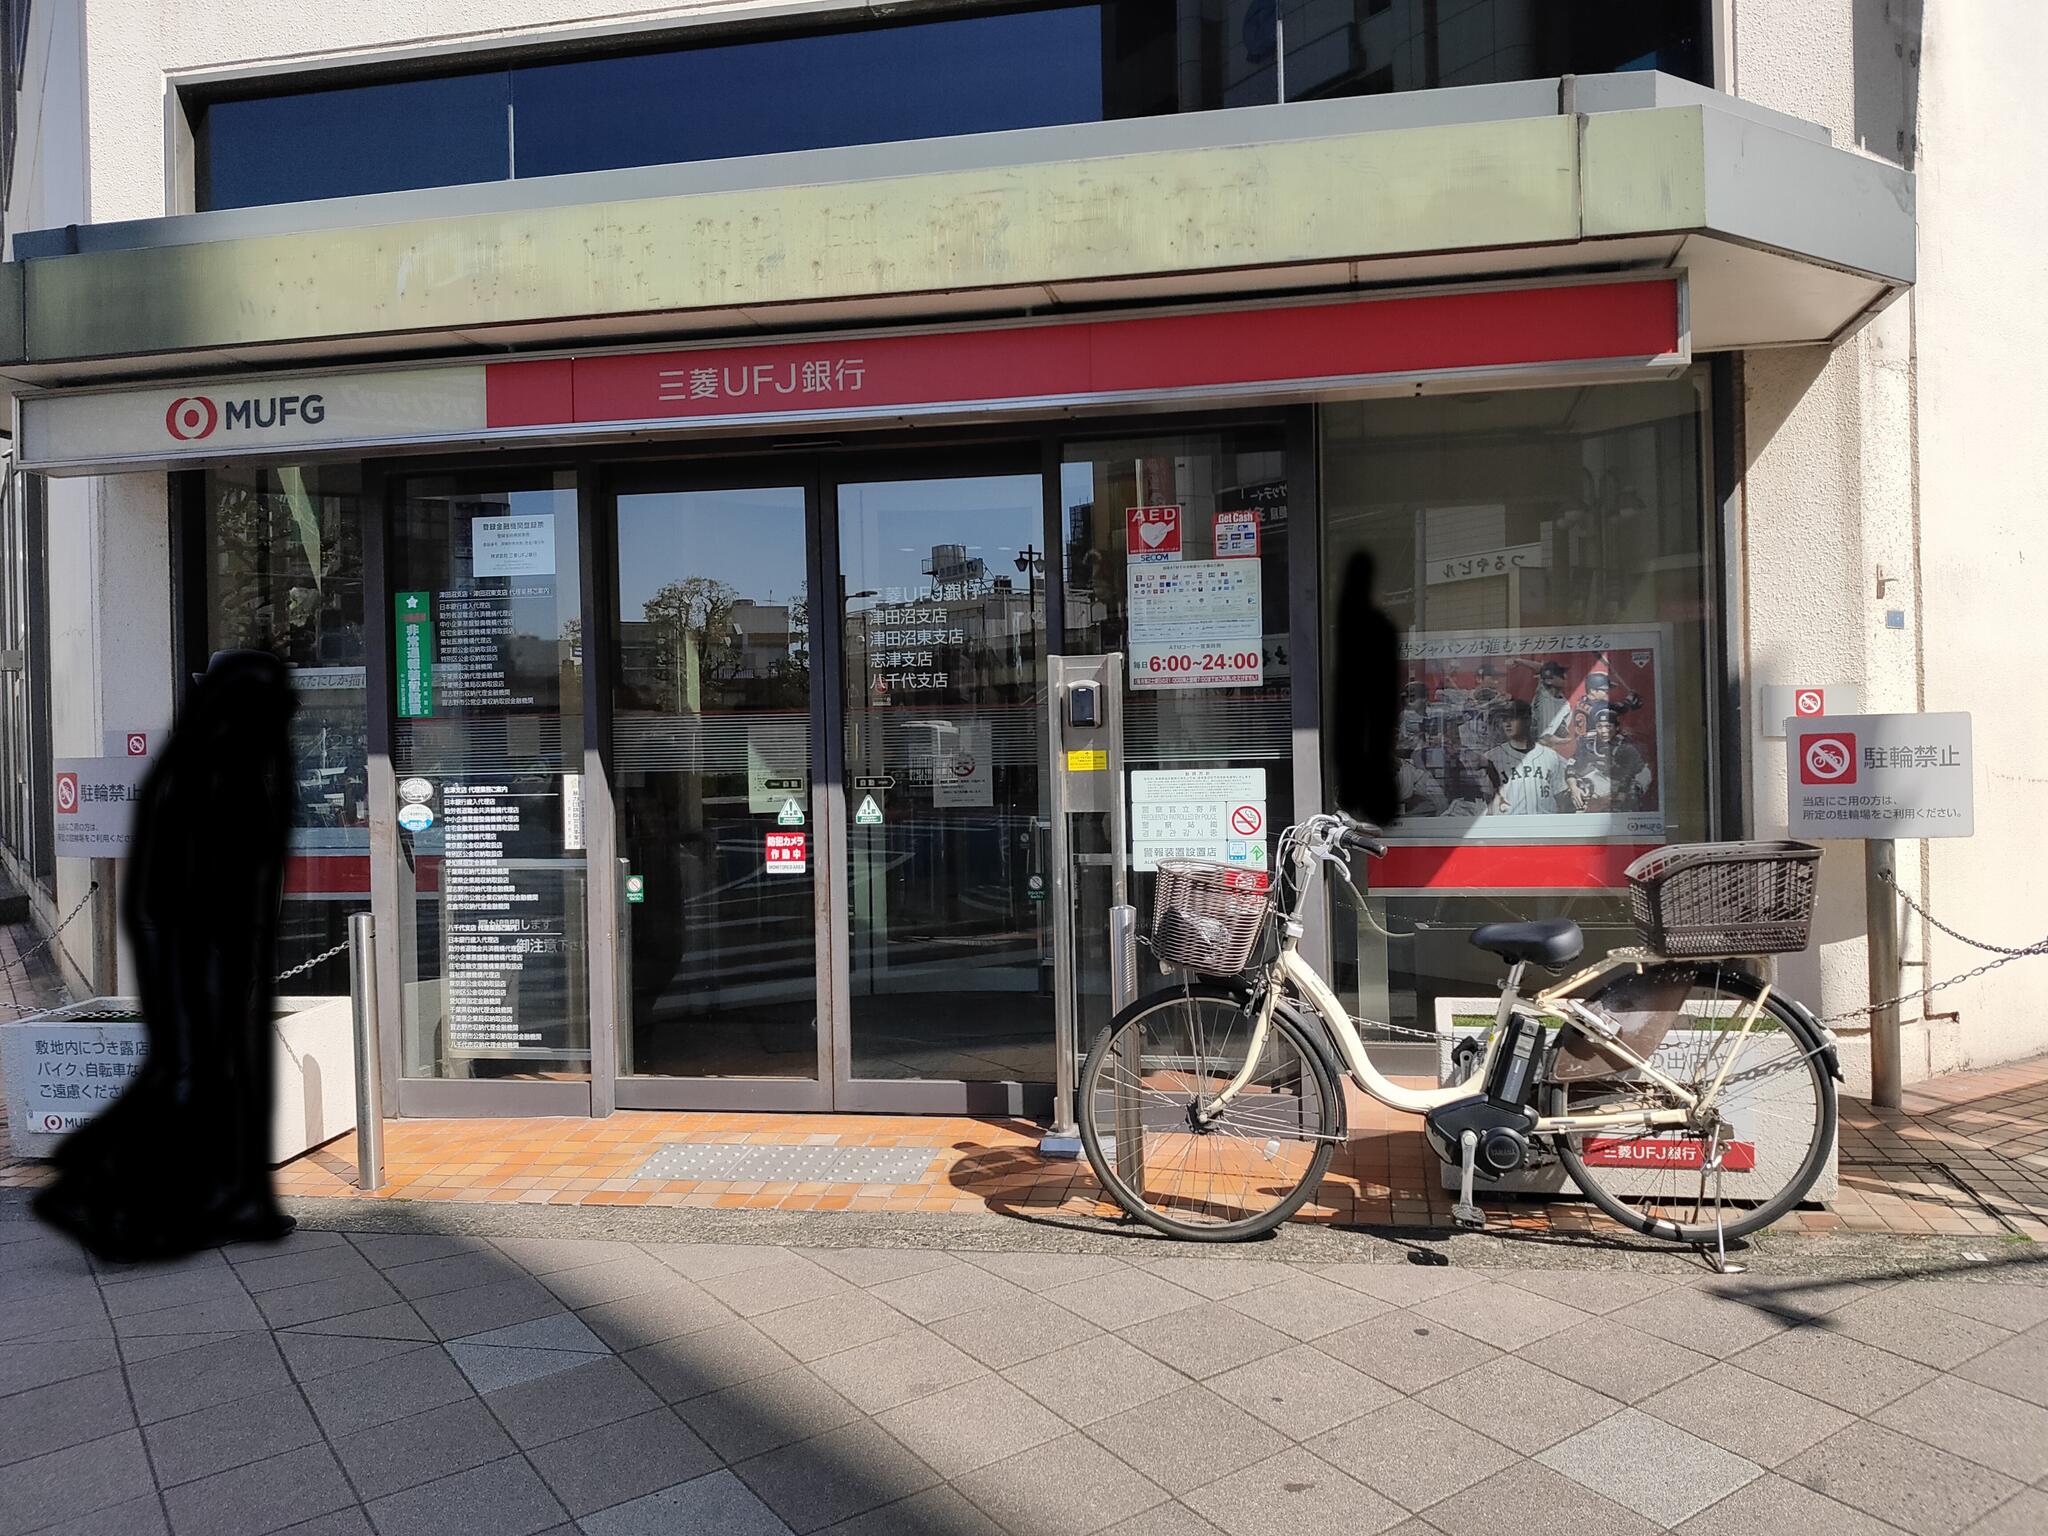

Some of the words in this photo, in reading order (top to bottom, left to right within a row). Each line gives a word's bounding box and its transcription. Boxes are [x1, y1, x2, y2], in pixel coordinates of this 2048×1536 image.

[657, 358, 867, 402] 三菱UFJ銀行
[224, 393, 326, 431] MUFG
[1131, 507, 1177, 523] AED
[1218, 513, 1232, 524] Get
[1232, 511, 1254, 523] Cash
[1140, 552, 1169, 561] SECOM
[868, 582, 981, 605] 三菱UFJ銀行
[869, 607, 948, 626] 津田沼支店
[869, 628, 964, 648] 津田沼東支店
[869, 650, 933, 668] 志津支店
[869, 671, 949, 690] 八千代支店
[1863, 744, 1962, 769] 駐輪禁止
[80, 783, 144, 803] 駐輪禁止
[1802, 795, 1898, 808] 当店にご用の方は、
[1802, 808, 1963, 821] 所定の駐輪場をご利用ください。
[767, 836, 805, 847] 防犯カメラ
[771, 848, 802, 860] 作動中
